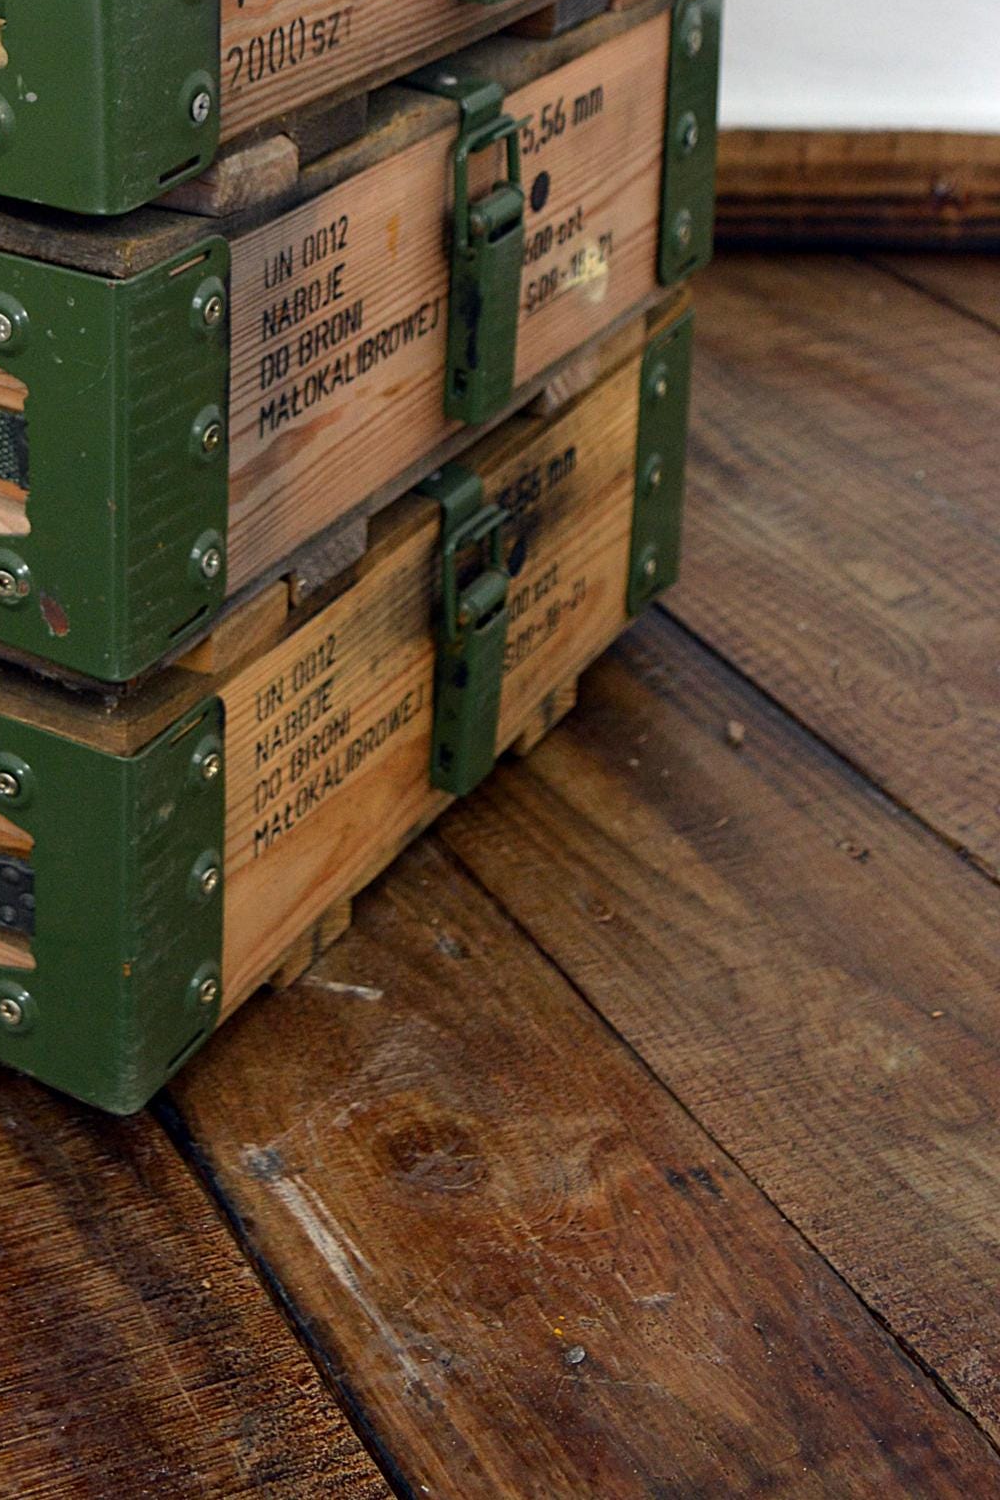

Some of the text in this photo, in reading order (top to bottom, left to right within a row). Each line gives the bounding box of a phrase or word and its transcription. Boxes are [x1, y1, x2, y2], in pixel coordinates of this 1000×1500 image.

[573, 84, 603, 126] mm
[264, 214, 349, 289] UN 0012
[260, 300, 363, 390] DO BRONI
[262, 261, 347, 342] NABOJE
[258, 296, 441, 439] MAŁOKALIBROWEJ
[256, 633, 336, 723] UN 0012
[255, 707, 351, 814] DO BRONI
[256, 677, 334, 770] NABOJE
[254, 683, 424, 859] MAŁOKALIBROWEJ
